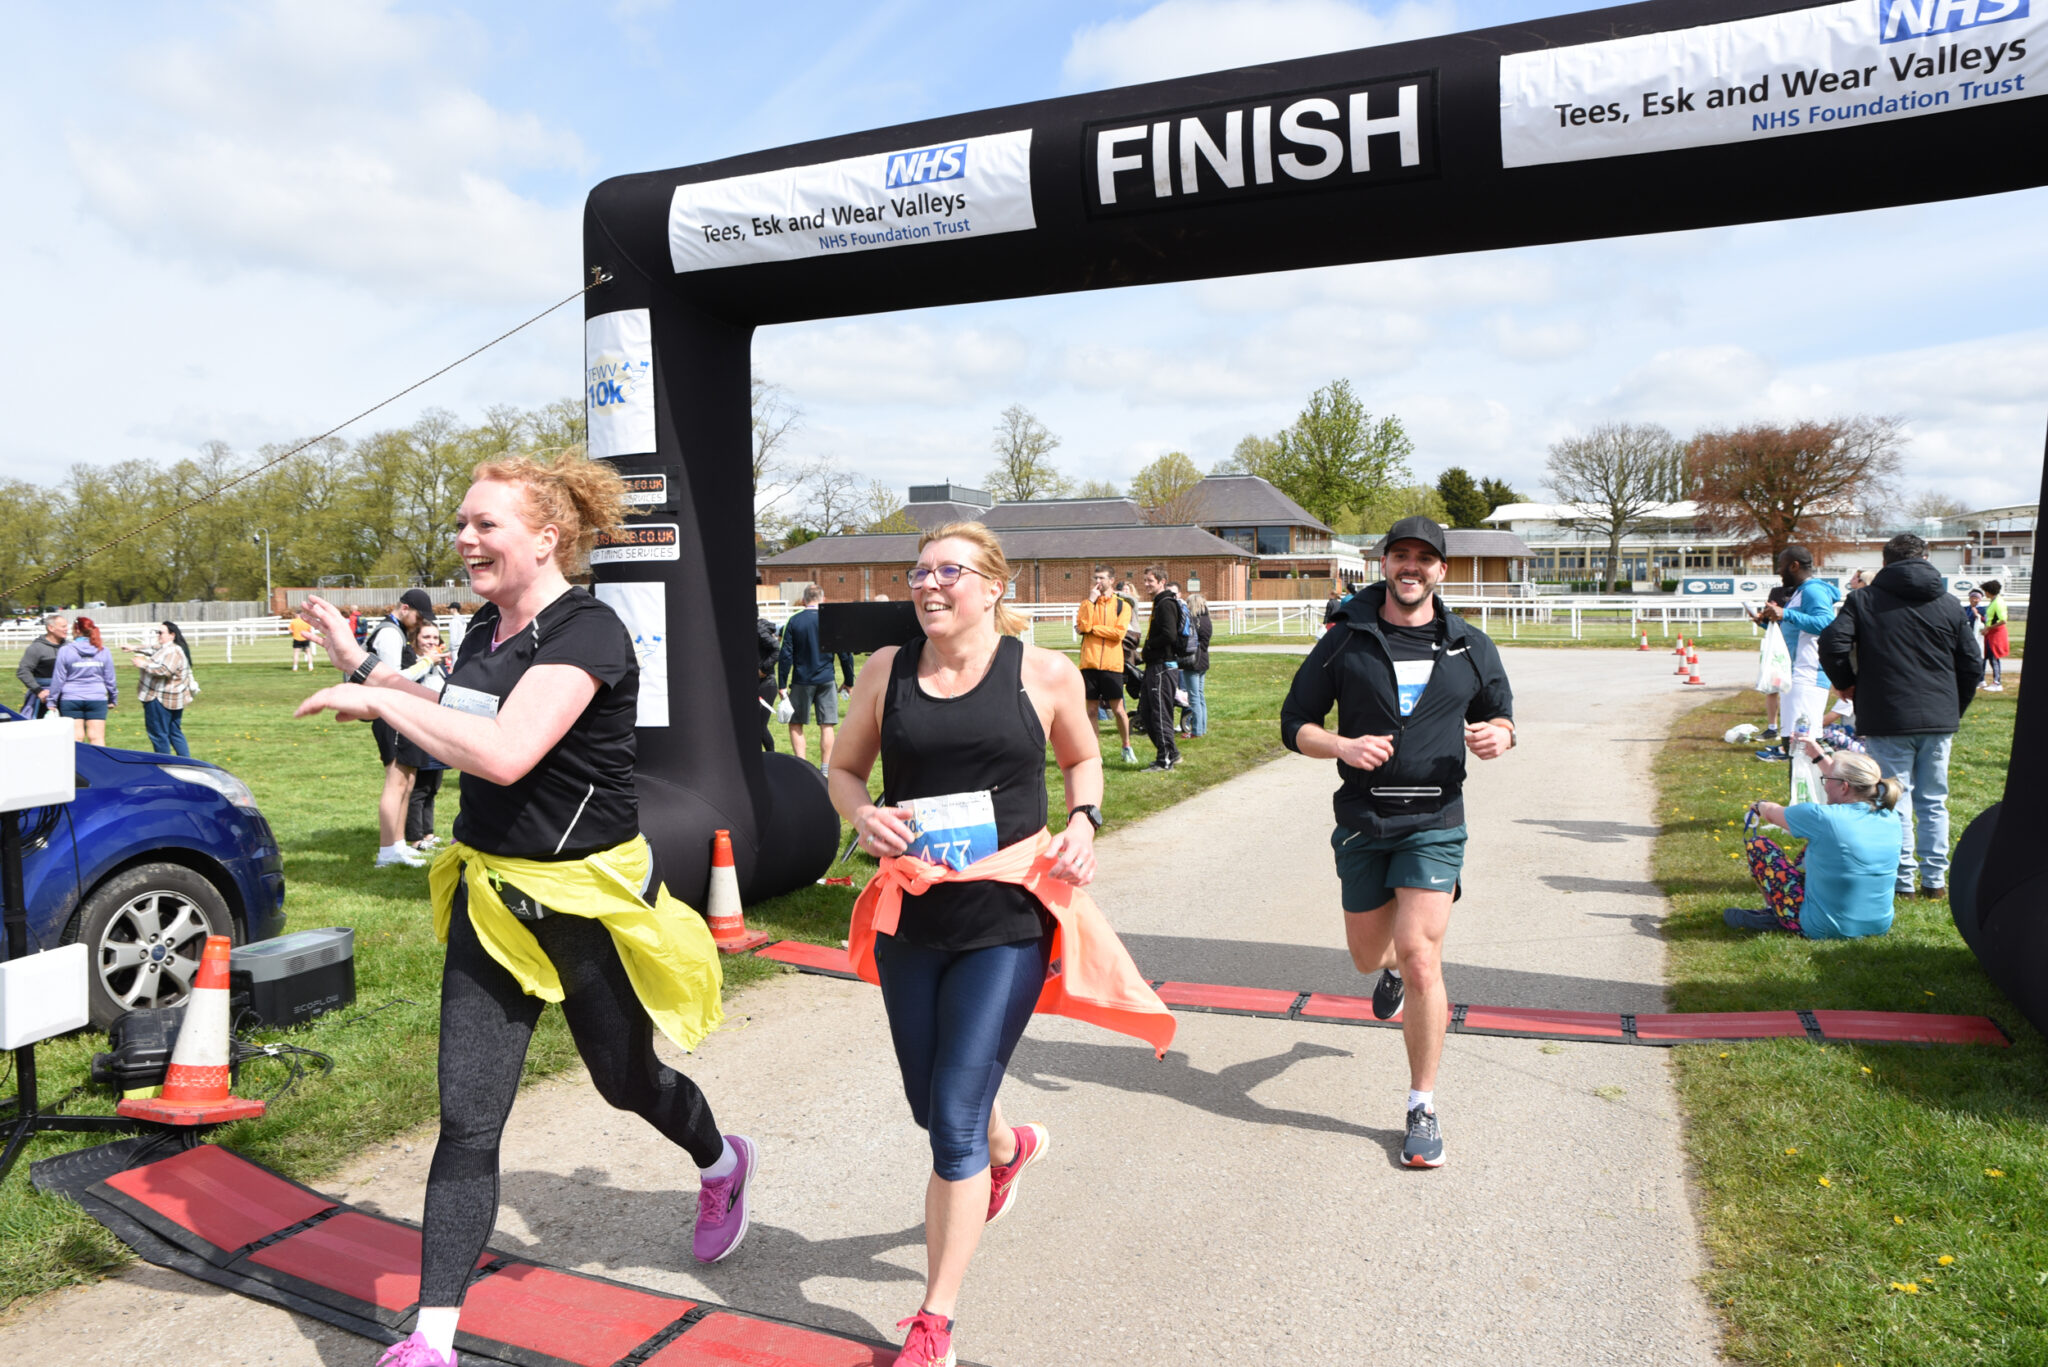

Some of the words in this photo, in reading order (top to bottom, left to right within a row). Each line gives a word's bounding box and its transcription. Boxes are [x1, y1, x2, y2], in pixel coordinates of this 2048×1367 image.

[1554, 102, 1630, 128] Tees,
[1643, 87, 1696, 117] Esk
[1706, 74, 1769, 109] and
[1782, 68, 1877, 99] Wear
[1889, 38, 2027, 82] Valleys
[1752, 109, 1800, 132] NHS
[1808, 90, 1950, 124] Foundation
[1959, 73, 2025, 101] Trust
[1097, 84, 1420, 205] FINISH
[886, 145, 966, 188] NHS
[701, 224, 746, 243] Tees,
[752, 214, 784, 236] Esk
[788, 207, 825, 232] and
[832, 204, 885, 226] Wear
[891, 192, 966, 217] Valleys
[818, 234, 847, 250] NHS
[850, 225, 931, 246] Foundation
[933, 218, 972, 236] Trust
[588, 362, 617, 382] TEWV
[588, 379, 626, 408] 10k
[626, 547, 674, 559] SERVICES
[1709, 581, 1731, 590] York
